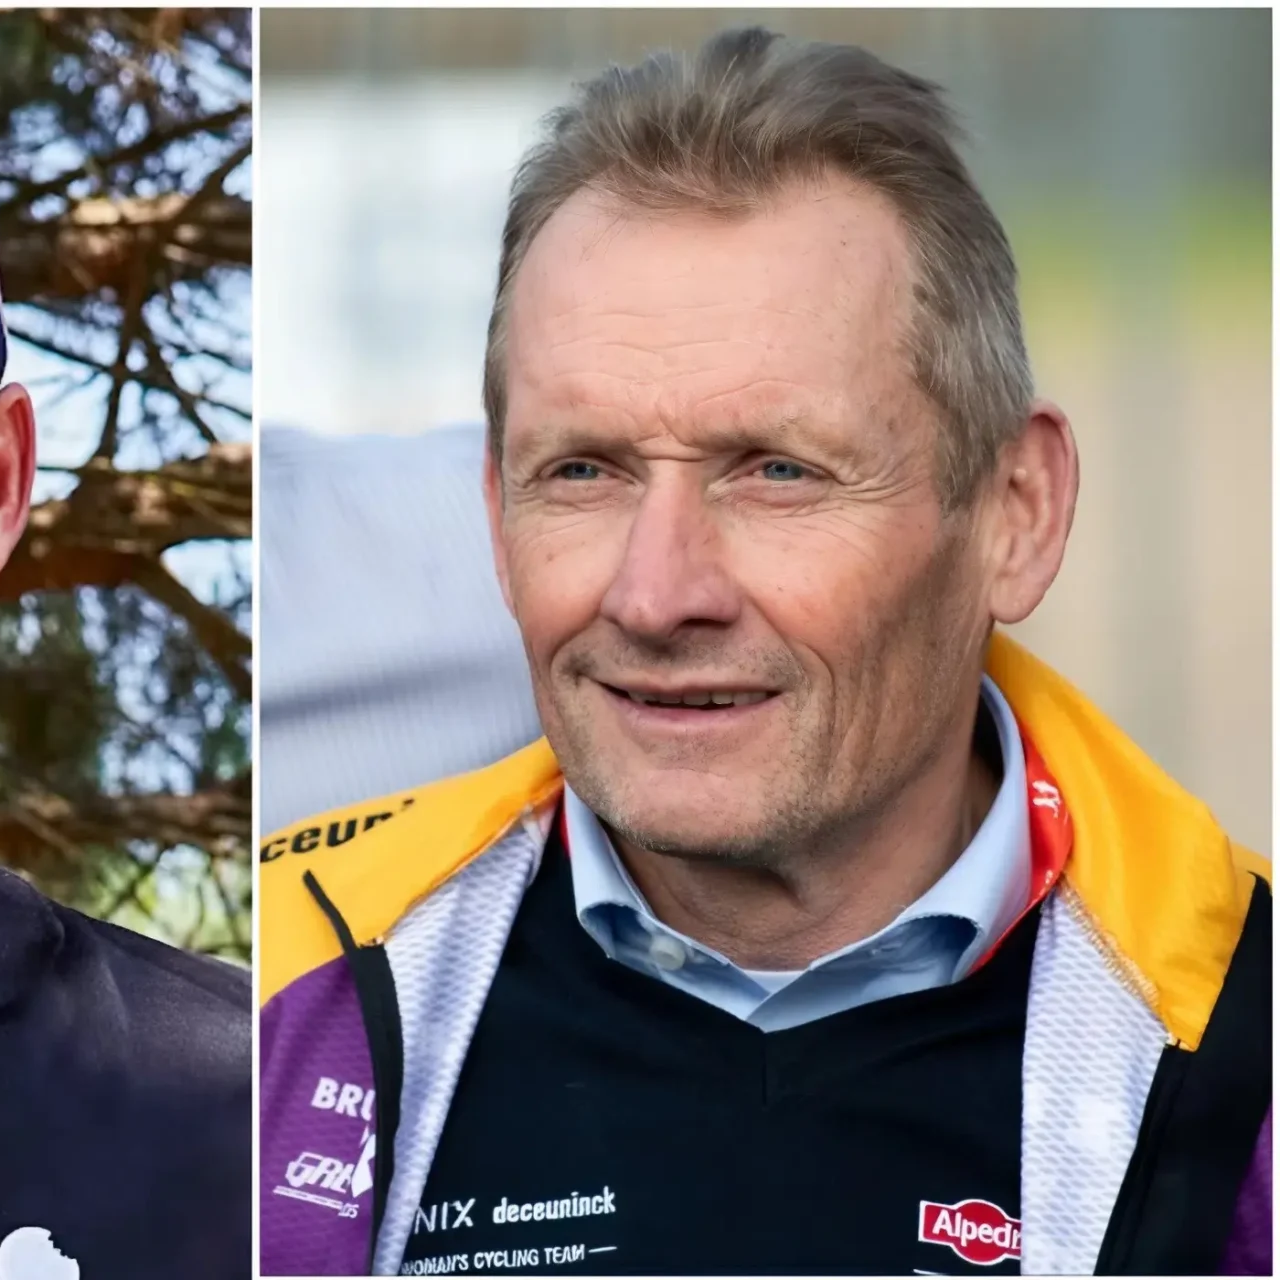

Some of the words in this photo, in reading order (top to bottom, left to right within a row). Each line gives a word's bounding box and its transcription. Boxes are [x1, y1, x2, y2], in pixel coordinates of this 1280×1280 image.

[493, 1186, 616, 1224] deceuninck
[474, 1249, 539, 1269] CYCLING
[544, 1244, 585, 1264] TEAM
